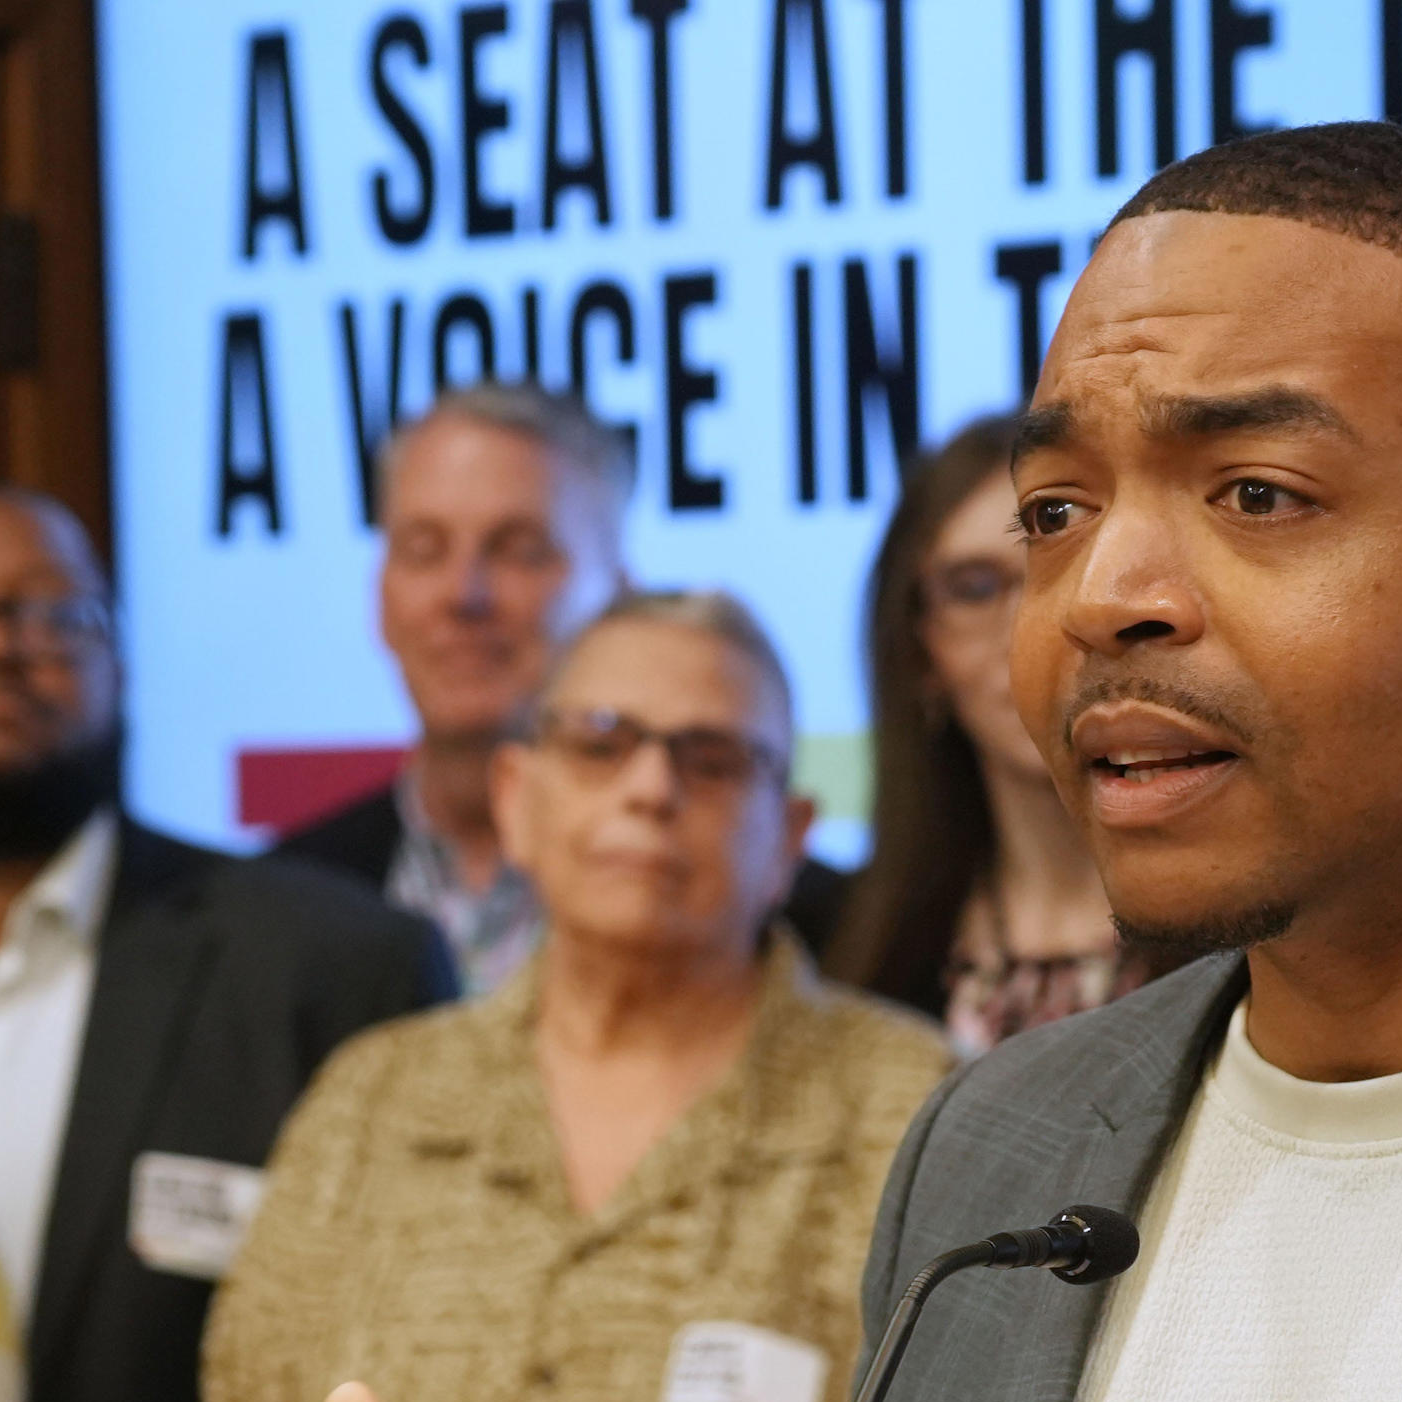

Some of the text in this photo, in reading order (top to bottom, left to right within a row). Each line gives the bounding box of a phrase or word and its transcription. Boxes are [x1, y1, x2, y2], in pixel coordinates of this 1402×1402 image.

[241, 31, 307, 260] A
[371, 0, 688, 247] SEAT
[764, 0, 907, 209] AT
[216, 312, 283, 537] A
[792, 253, 919, 506] IN
